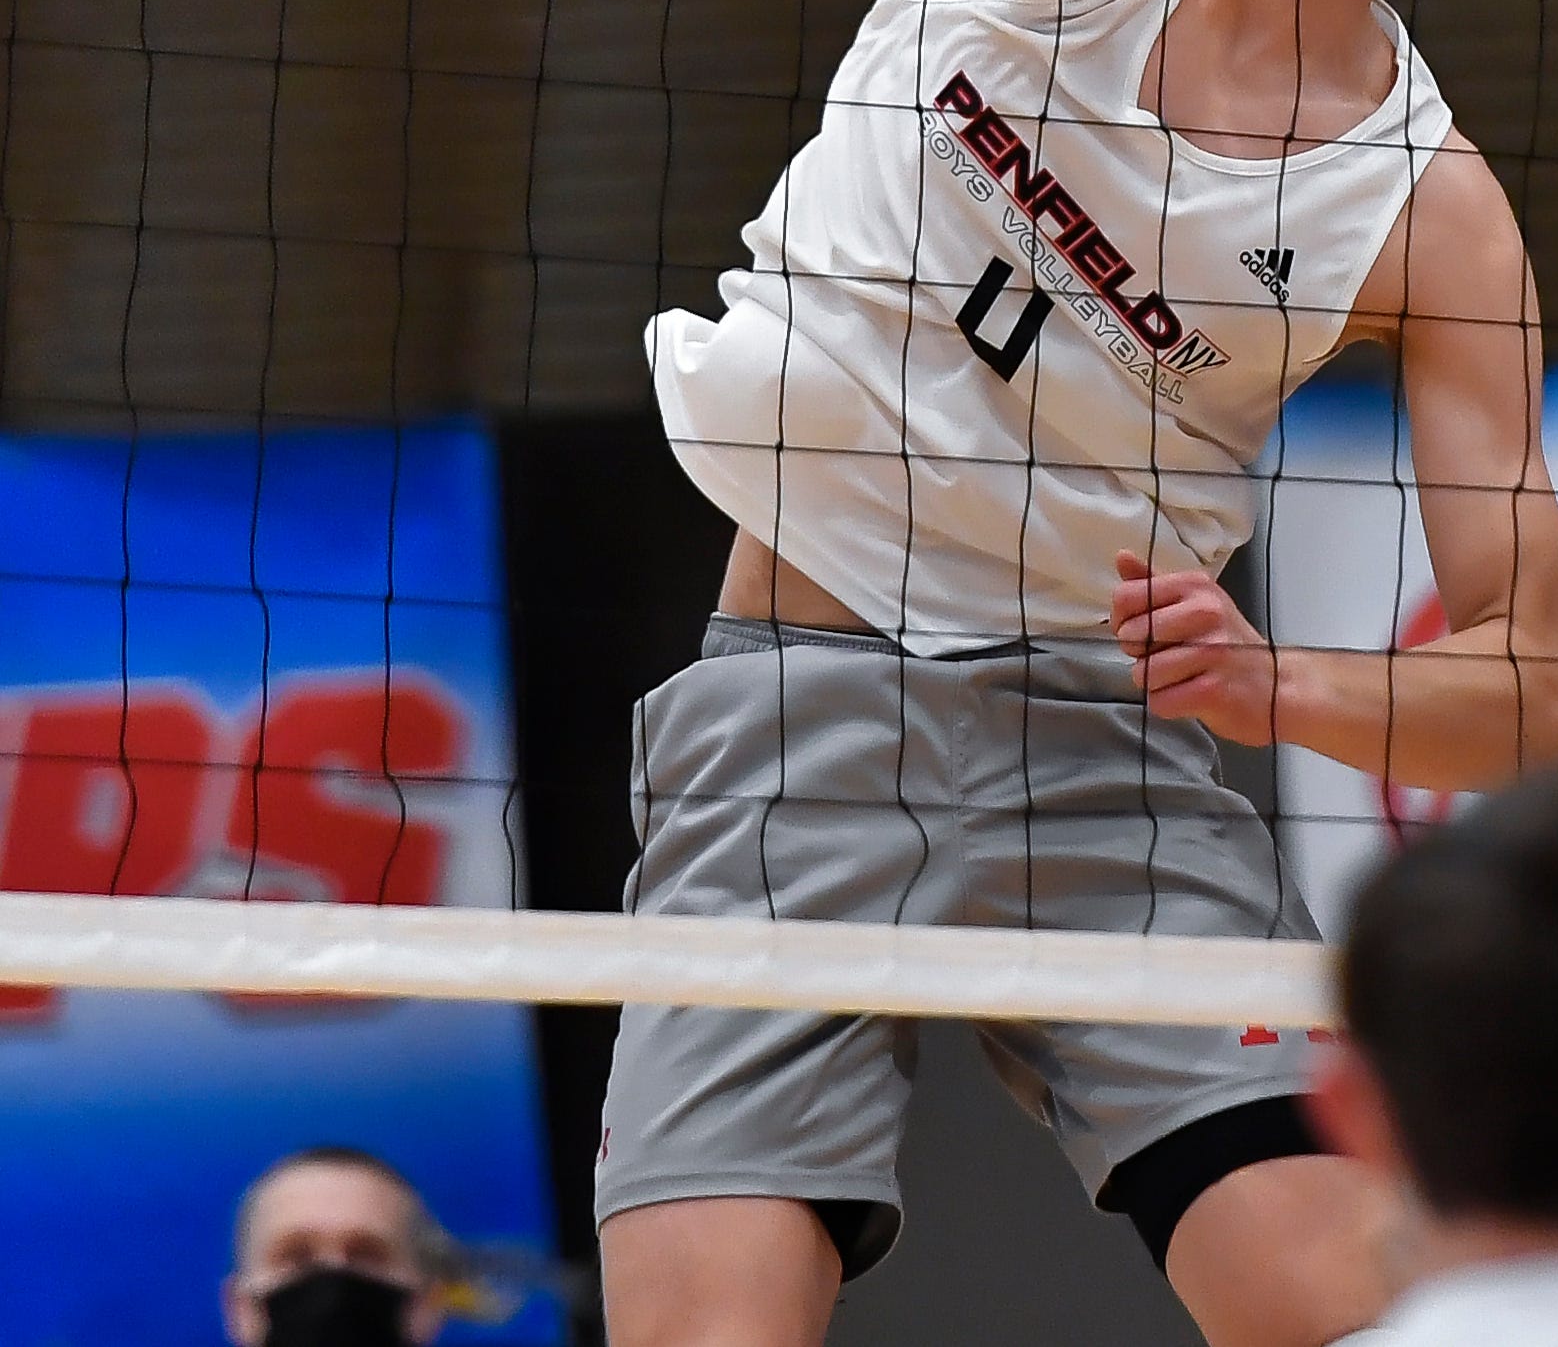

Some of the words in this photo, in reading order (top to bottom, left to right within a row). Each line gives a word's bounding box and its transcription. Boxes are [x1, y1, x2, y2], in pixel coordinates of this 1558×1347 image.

[919, 111, 995, 203] BOYS
[1002, 205, 1184, 404] VOLLEYBALL
[934, 69, 1182, 350] PENFIELD
[1165, 335, 1227, 374] NY
[1239, 251, 1290, 303] adidas
